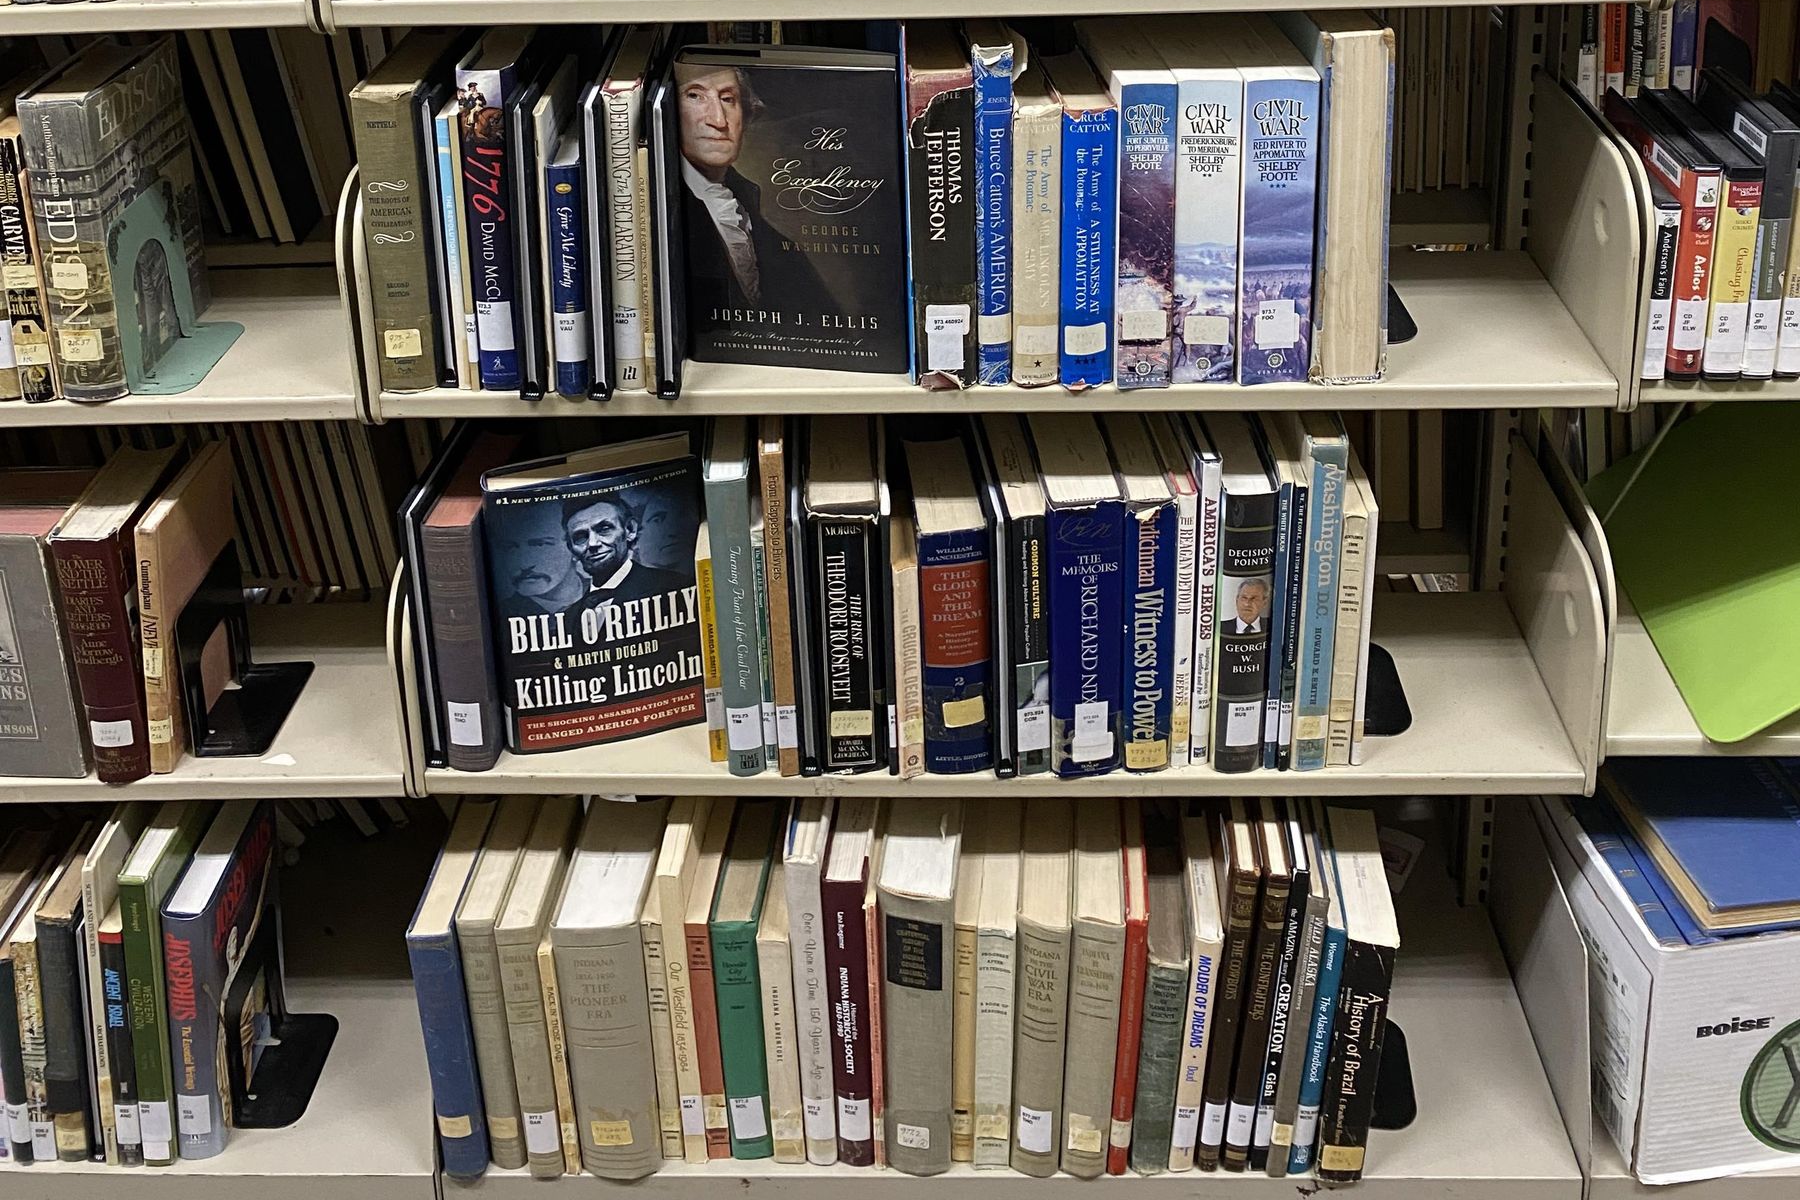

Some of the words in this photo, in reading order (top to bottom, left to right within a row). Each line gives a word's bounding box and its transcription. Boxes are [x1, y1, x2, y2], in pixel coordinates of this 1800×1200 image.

[1125, 104, 1169, 122] CIVIL
[1185, 103, 1232, 122] CIVIL
[1254, 99, 1308, 121] CIVIL
[1069, 123, 1111, 132] CATTON
[1128, 121, 1163, 135] WAR
[1190, 119, 1225, 135] WAR
[1259, 118, 1300, 136] WAR
[803, 127, 848, 151] His
[945, 126, 963, 204] THOMAS
[1129, 154, 1164, 162] SHELBY
[1131, 162, 1162, 170] FOOTE
[1189, 156, 1226, 165] SHELBY
[1190, 163, 1223, 172] FOOTE
[1258, 162, 1301, 172] SHELBY
[465, 147, 506, 222] 1776
[924, 127, 946, 242] JEFFERSON
[1260, 171, 1298, 181] FOOTE
[770, 158, 886, 215] Excellency
[480, 221, 495, 259] DAVID
[802, 224, 859, 237] GEORGE
[781, 242, 882, 256] WASHINGTON
[711, 308, 781, 324] JOSEPH
[796, 312, 811, 326] J.
[822, 315, 878, 329] ELLIS
[825, 525, 862, 536] MORRIS
[1204, 497, 1217, 576] AMERICA'S
[1077, 555, 1101, 564] THE
[1228, 547, 1274, 558] DECISION
[1234, 557, 1269, 567] POINTS
[1062, 562, 1118, 576] MEMOIRS
[826, 552, 848, 630] THEODORE
[508, 613, 573, 655] BILL
[581, 586, 698, 645] O'REILLY
[1200, 584, 1214, 640] HEROES
[554, 658, 563, 669] &
[568, 650, 611, 669] MARTIN
[616, 639, 659, 661] DUGARD
[1225, 641, 1267, 653] GEORGE
[830, 630, 851, 703] ROOSEVELT
[1232, 663, 1260, 674] BUSH
[1241, 655, 1252, 663] W.
[514, 674, 608, 710] Killing
[612, 650, 703, 697] Lincoln
[528, 726, 584, 741] CHANGED
[587, 718, 640, 734] AMERICA
[643, 704, 696, 723] FOREVER
[1198, 955, 1212, 996] MOLDER
[1194, 996, 1207, 1009] OF
[1320, 996, 1331, 1015] The
[1270, 984, 1292, 1054] CREATION
[1344, 994, 1370, 1044] History
[1190, 1010, 1206, 1048] DREAMS
[1314, 1016, 1328, 1044] Alaska
[1346, 1044, 1362, 1059] of
[1309, 1045, 1326, 1083] Handbook
[1342, 1060, 1361, 1096] Brazil
